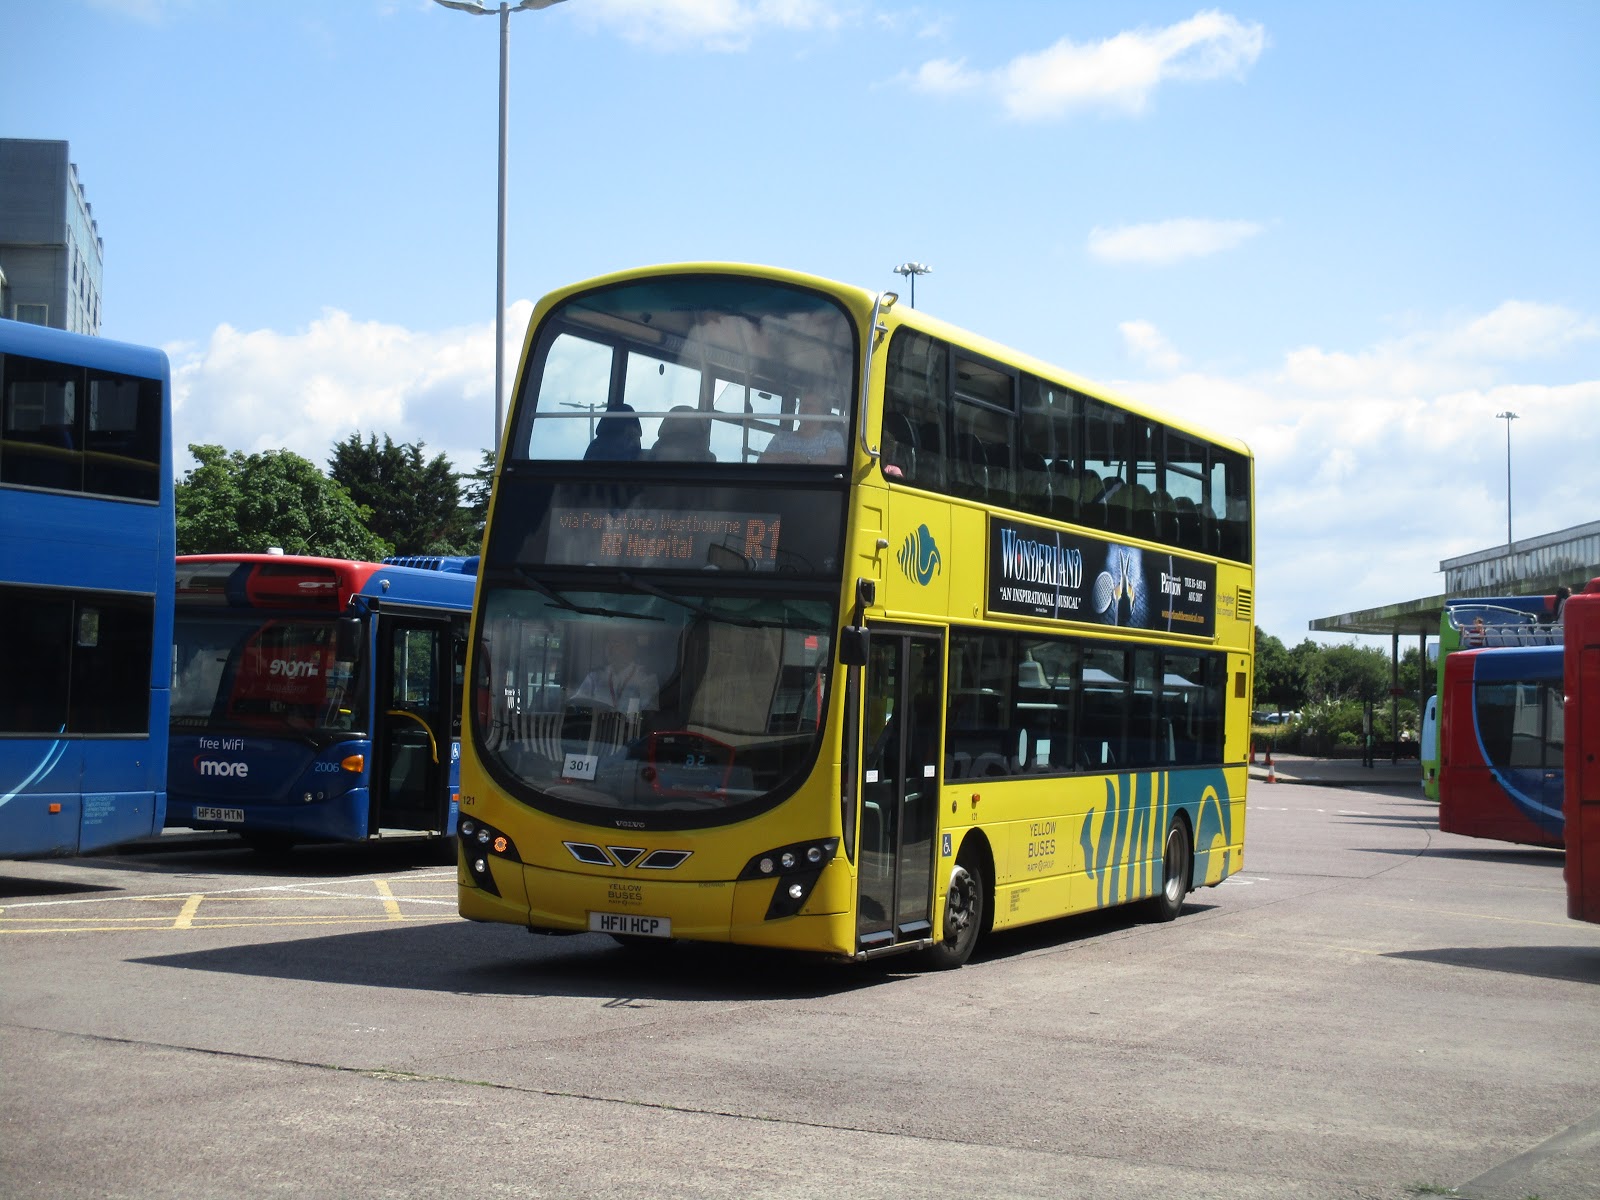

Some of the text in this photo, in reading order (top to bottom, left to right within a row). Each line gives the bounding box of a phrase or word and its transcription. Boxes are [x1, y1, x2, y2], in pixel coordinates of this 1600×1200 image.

[559, 512, 579, 528] via
[661, 515, 741, 533] Westbourne
[627, 533, 693, 558] Hospital
[745, 519, 781, 559] R1
[1001, 528, 1083, 589] WONDERLAND
[1012, 588, 1055, 607] INSPIRATIONAL
[199, 736, 244, 751] free WiFi
[200, 760, 249, 778] more
[314, 761, 340, 773] 2006
[569, 759, 591, 773] 301
[463, 796, 475, 806] 121
[198, 808, 243, 820] HF58 HTN
[615, 819, 646, 829] VOLVO
[1030, 821, 1057, 837] YELLOW
[1028, 839, 1056, 858] BUSES
[608, 883, 642, 892] YELLOW
[608, 891, 643, 901] BUSES
[631, 918, 659, 934] HCP
